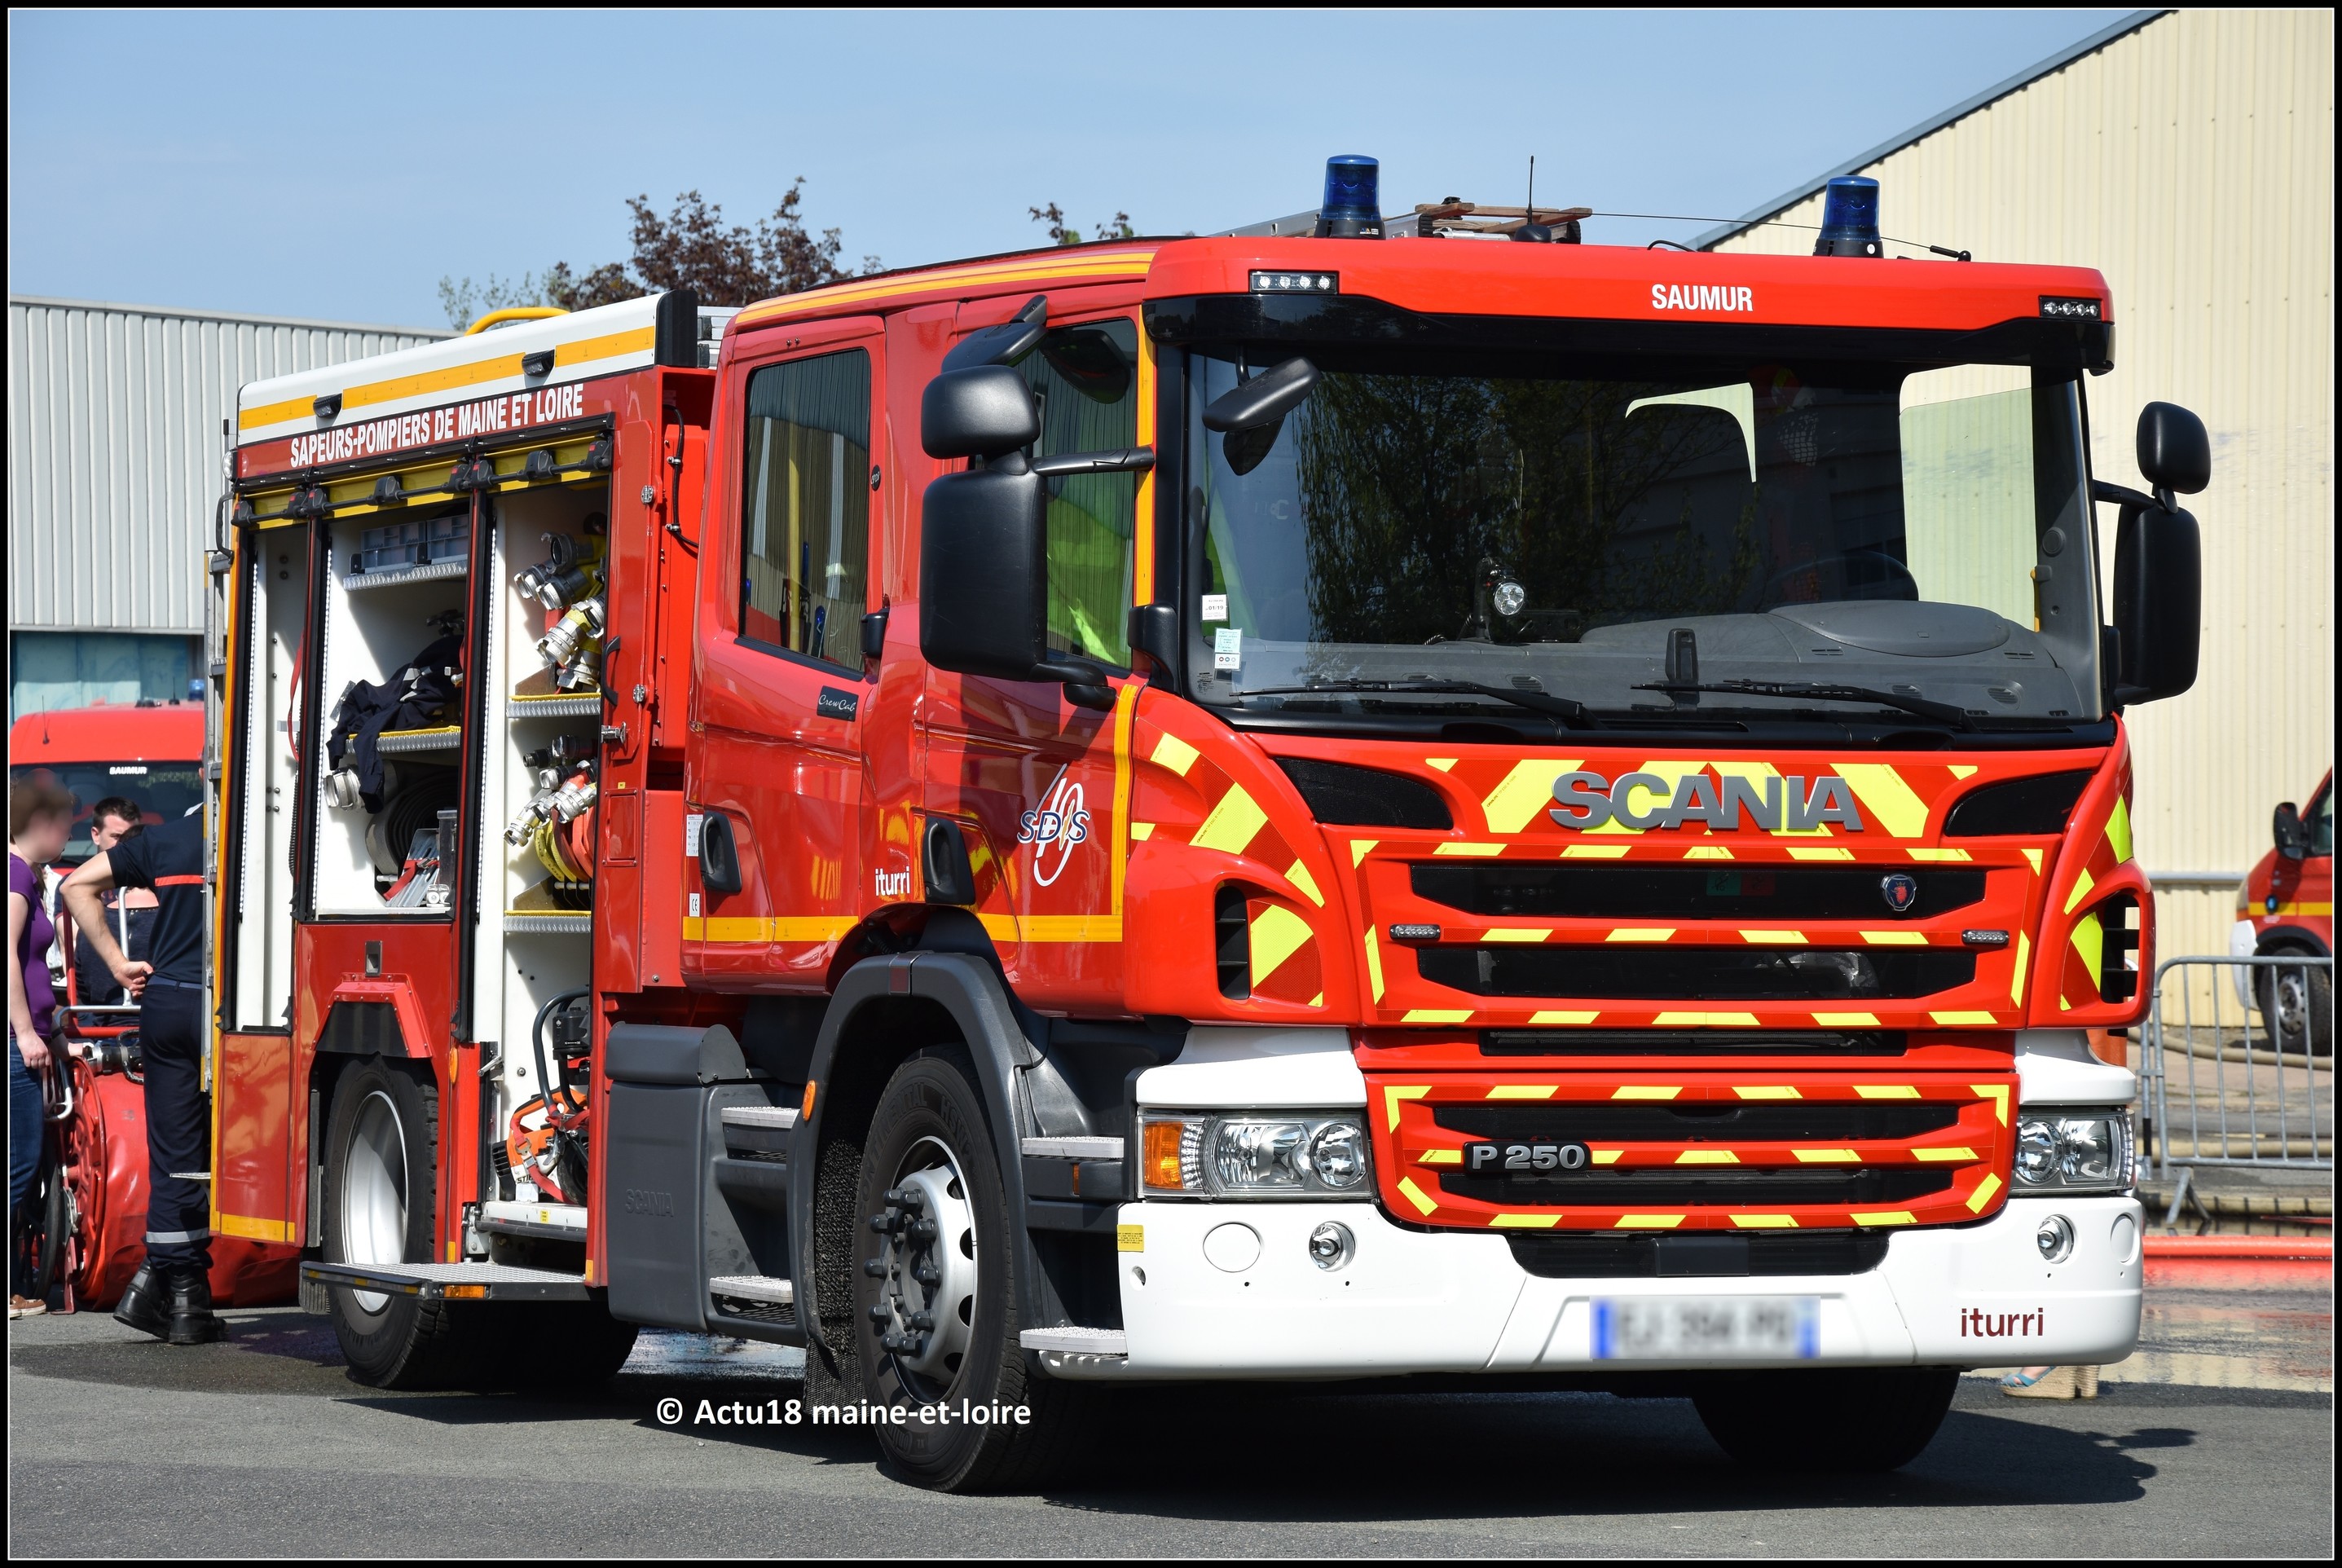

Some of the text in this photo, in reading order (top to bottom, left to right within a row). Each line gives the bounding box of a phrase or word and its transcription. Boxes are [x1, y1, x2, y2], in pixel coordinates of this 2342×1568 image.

[1651, 284, 1754, 311] SAUMUR
[290, 383, 583, 468] SAPEURS-POMPIERS DE MAINE ET LOIRE
[109, 766, 147, 776] SAUMUR
[1548, 770, 1864, 831] SCANIA
[875, 865, 910, 896] iturri
[1473, 1144, 1586, 1169] P 250
[625, 1188, 676, 1218] SCANIA
[1961, 1307, 2044, 1337] iturri
